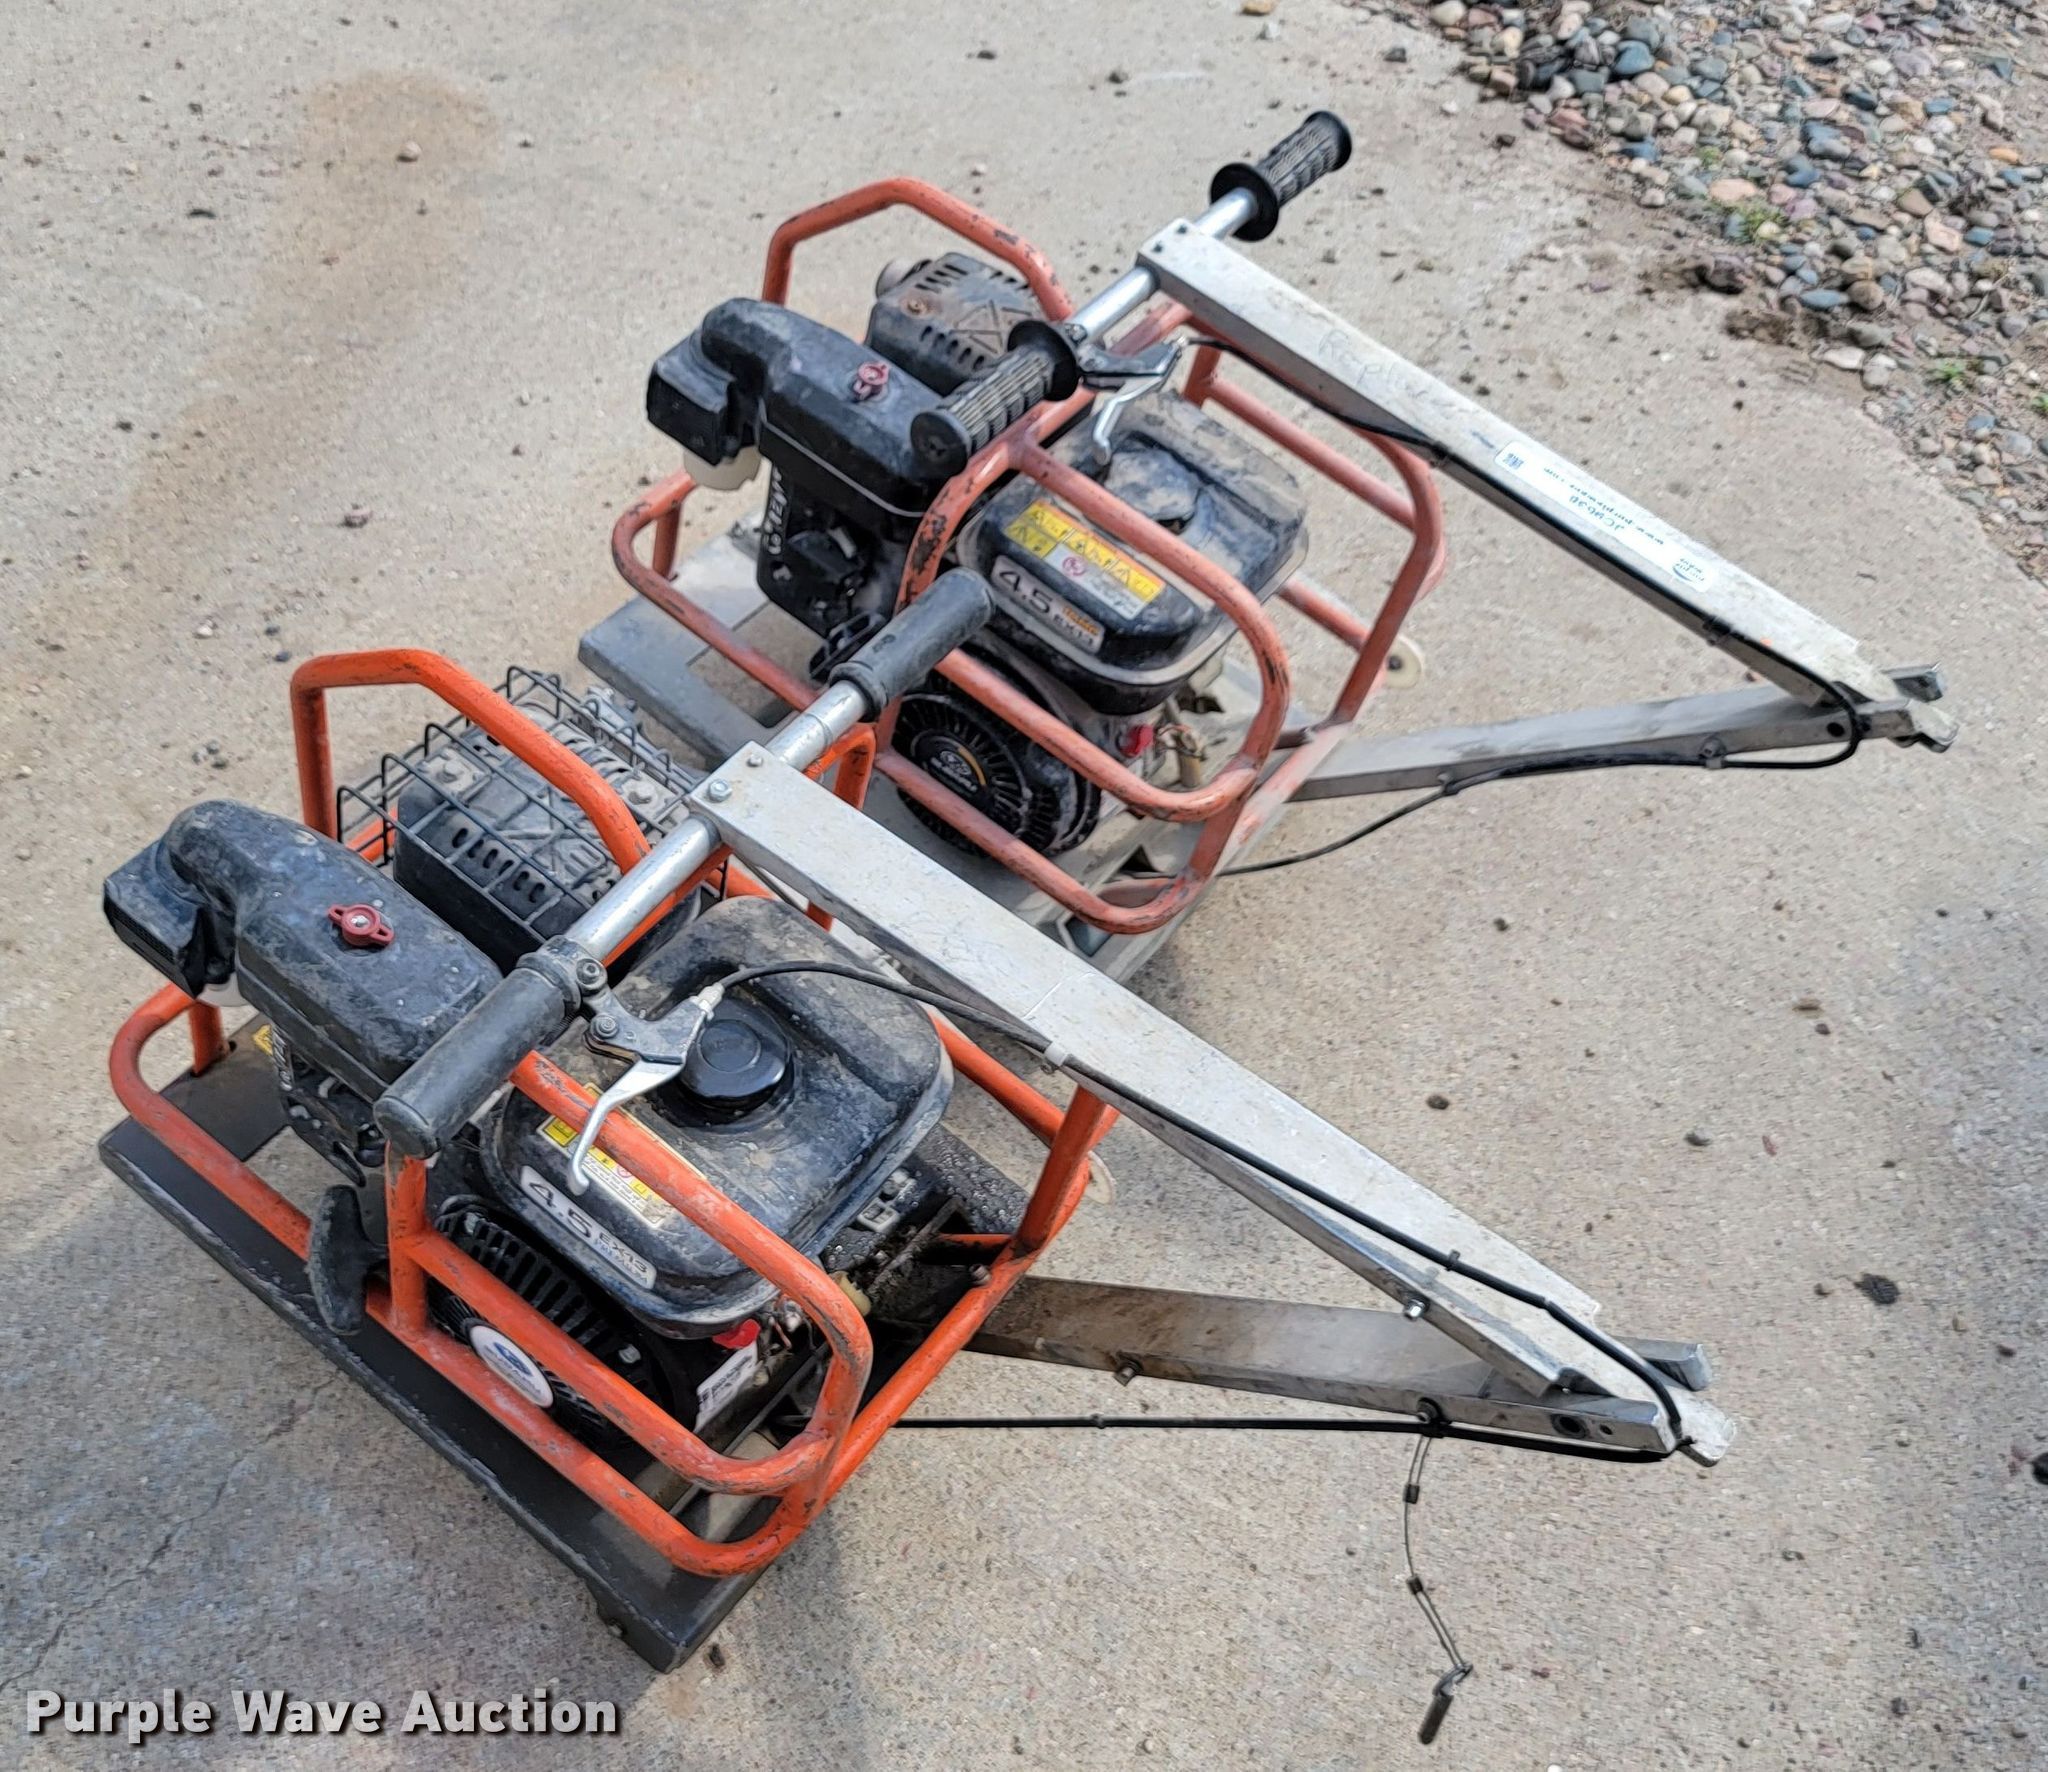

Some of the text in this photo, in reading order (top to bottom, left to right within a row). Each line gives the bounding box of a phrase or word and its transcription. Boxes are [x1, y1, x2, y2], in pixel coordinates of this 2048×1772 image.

[999, 570, 1052, 614] 4.5
[529, 1182, 593, 1239] 4.5
[599, 1232, 649, 1274] EX13
